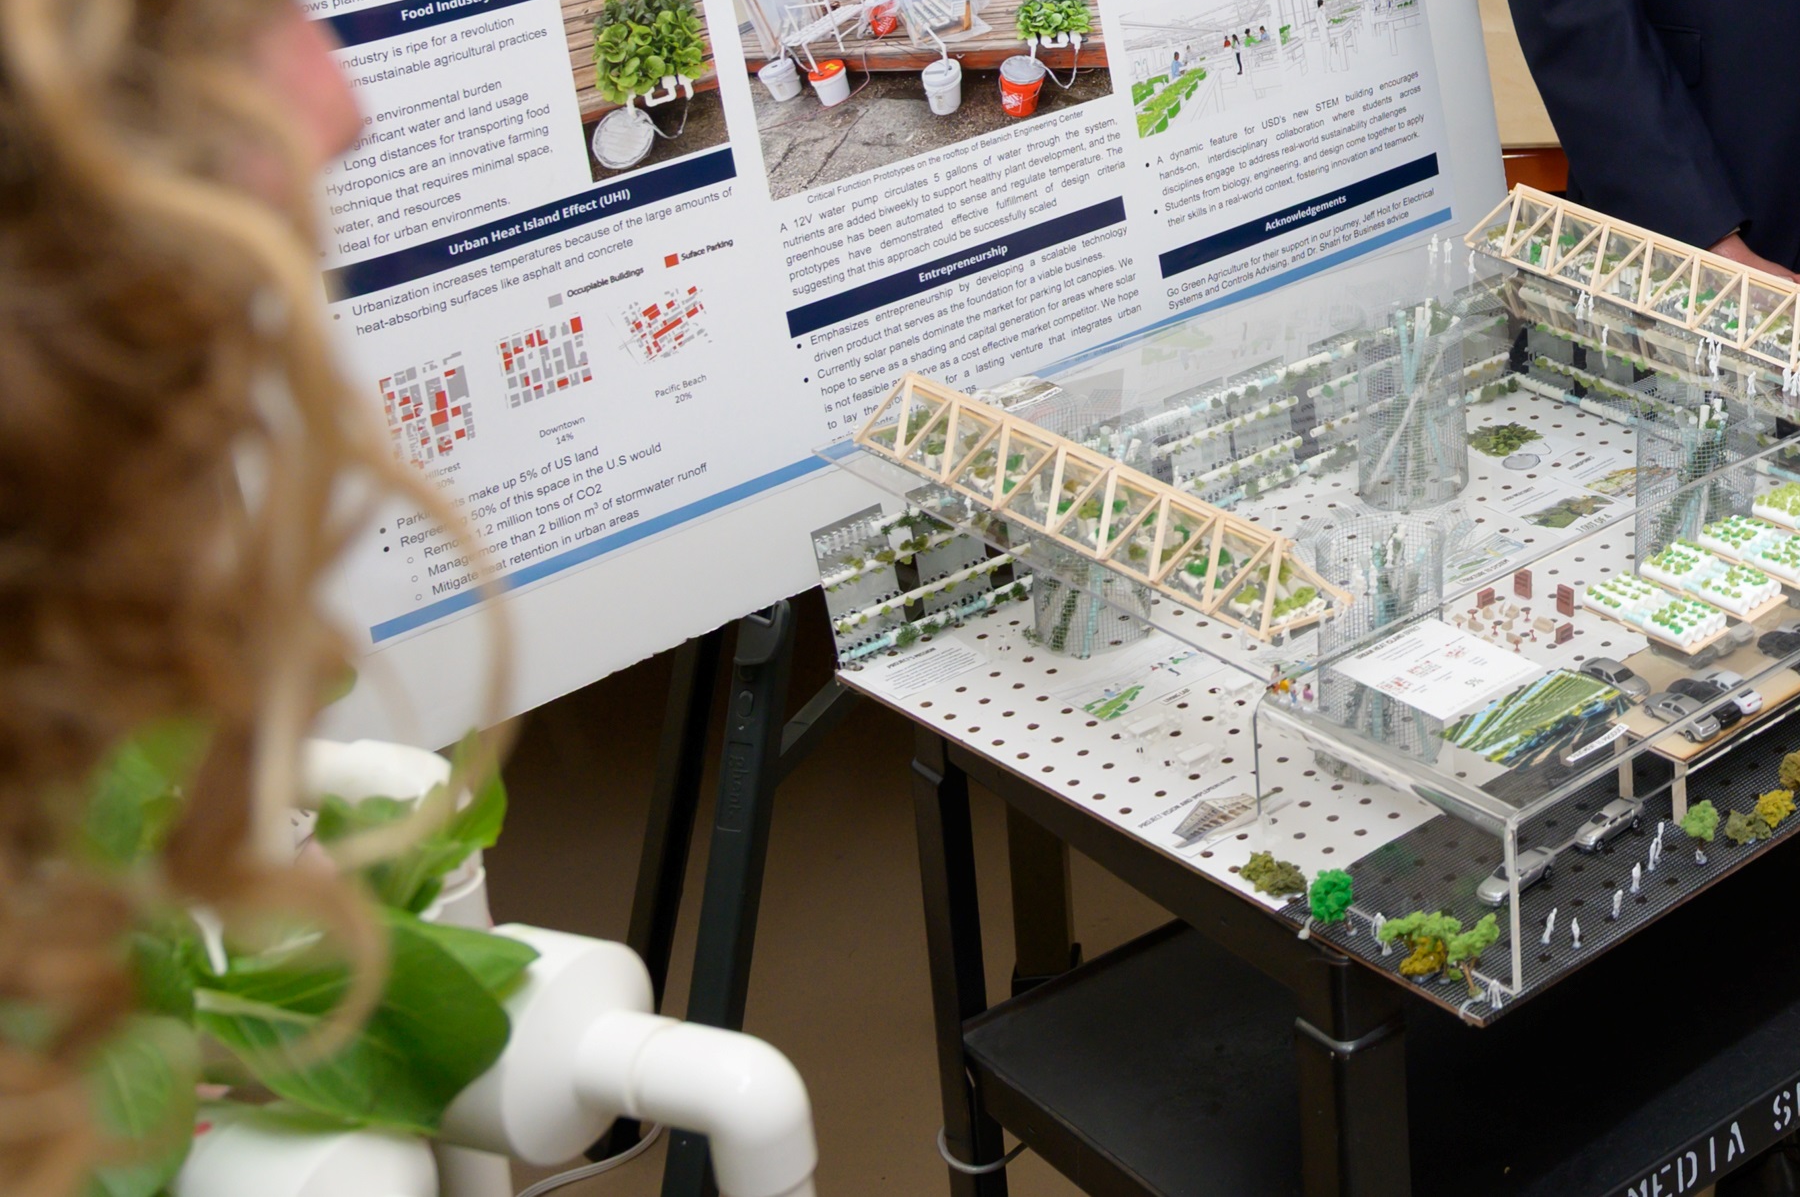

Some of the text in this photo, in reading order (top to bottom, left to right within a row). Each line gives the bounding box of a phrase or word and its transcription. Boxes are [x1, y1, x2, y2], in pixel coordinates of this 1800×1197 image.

[400, 1, 435, 22] Food
[806, 109, 1084, 204] Critical Function Prototypes on the rooftop of Belanich Engineering Center
[447, 187, 631, 256] Urban Heat Island Effect (UHI)
[1264, 194, 1347, 232] Acknowledgements
[917, 244, 1008, 283] Entrepreneurship
[355, 237, 634, 336] heat-absorbing surfaces like asphalt and concrete
[653, 373, 707, 398] Pacific Beach
[538, 416, 586, 439] Downtown
[555, 431, 575, 445] 14%
